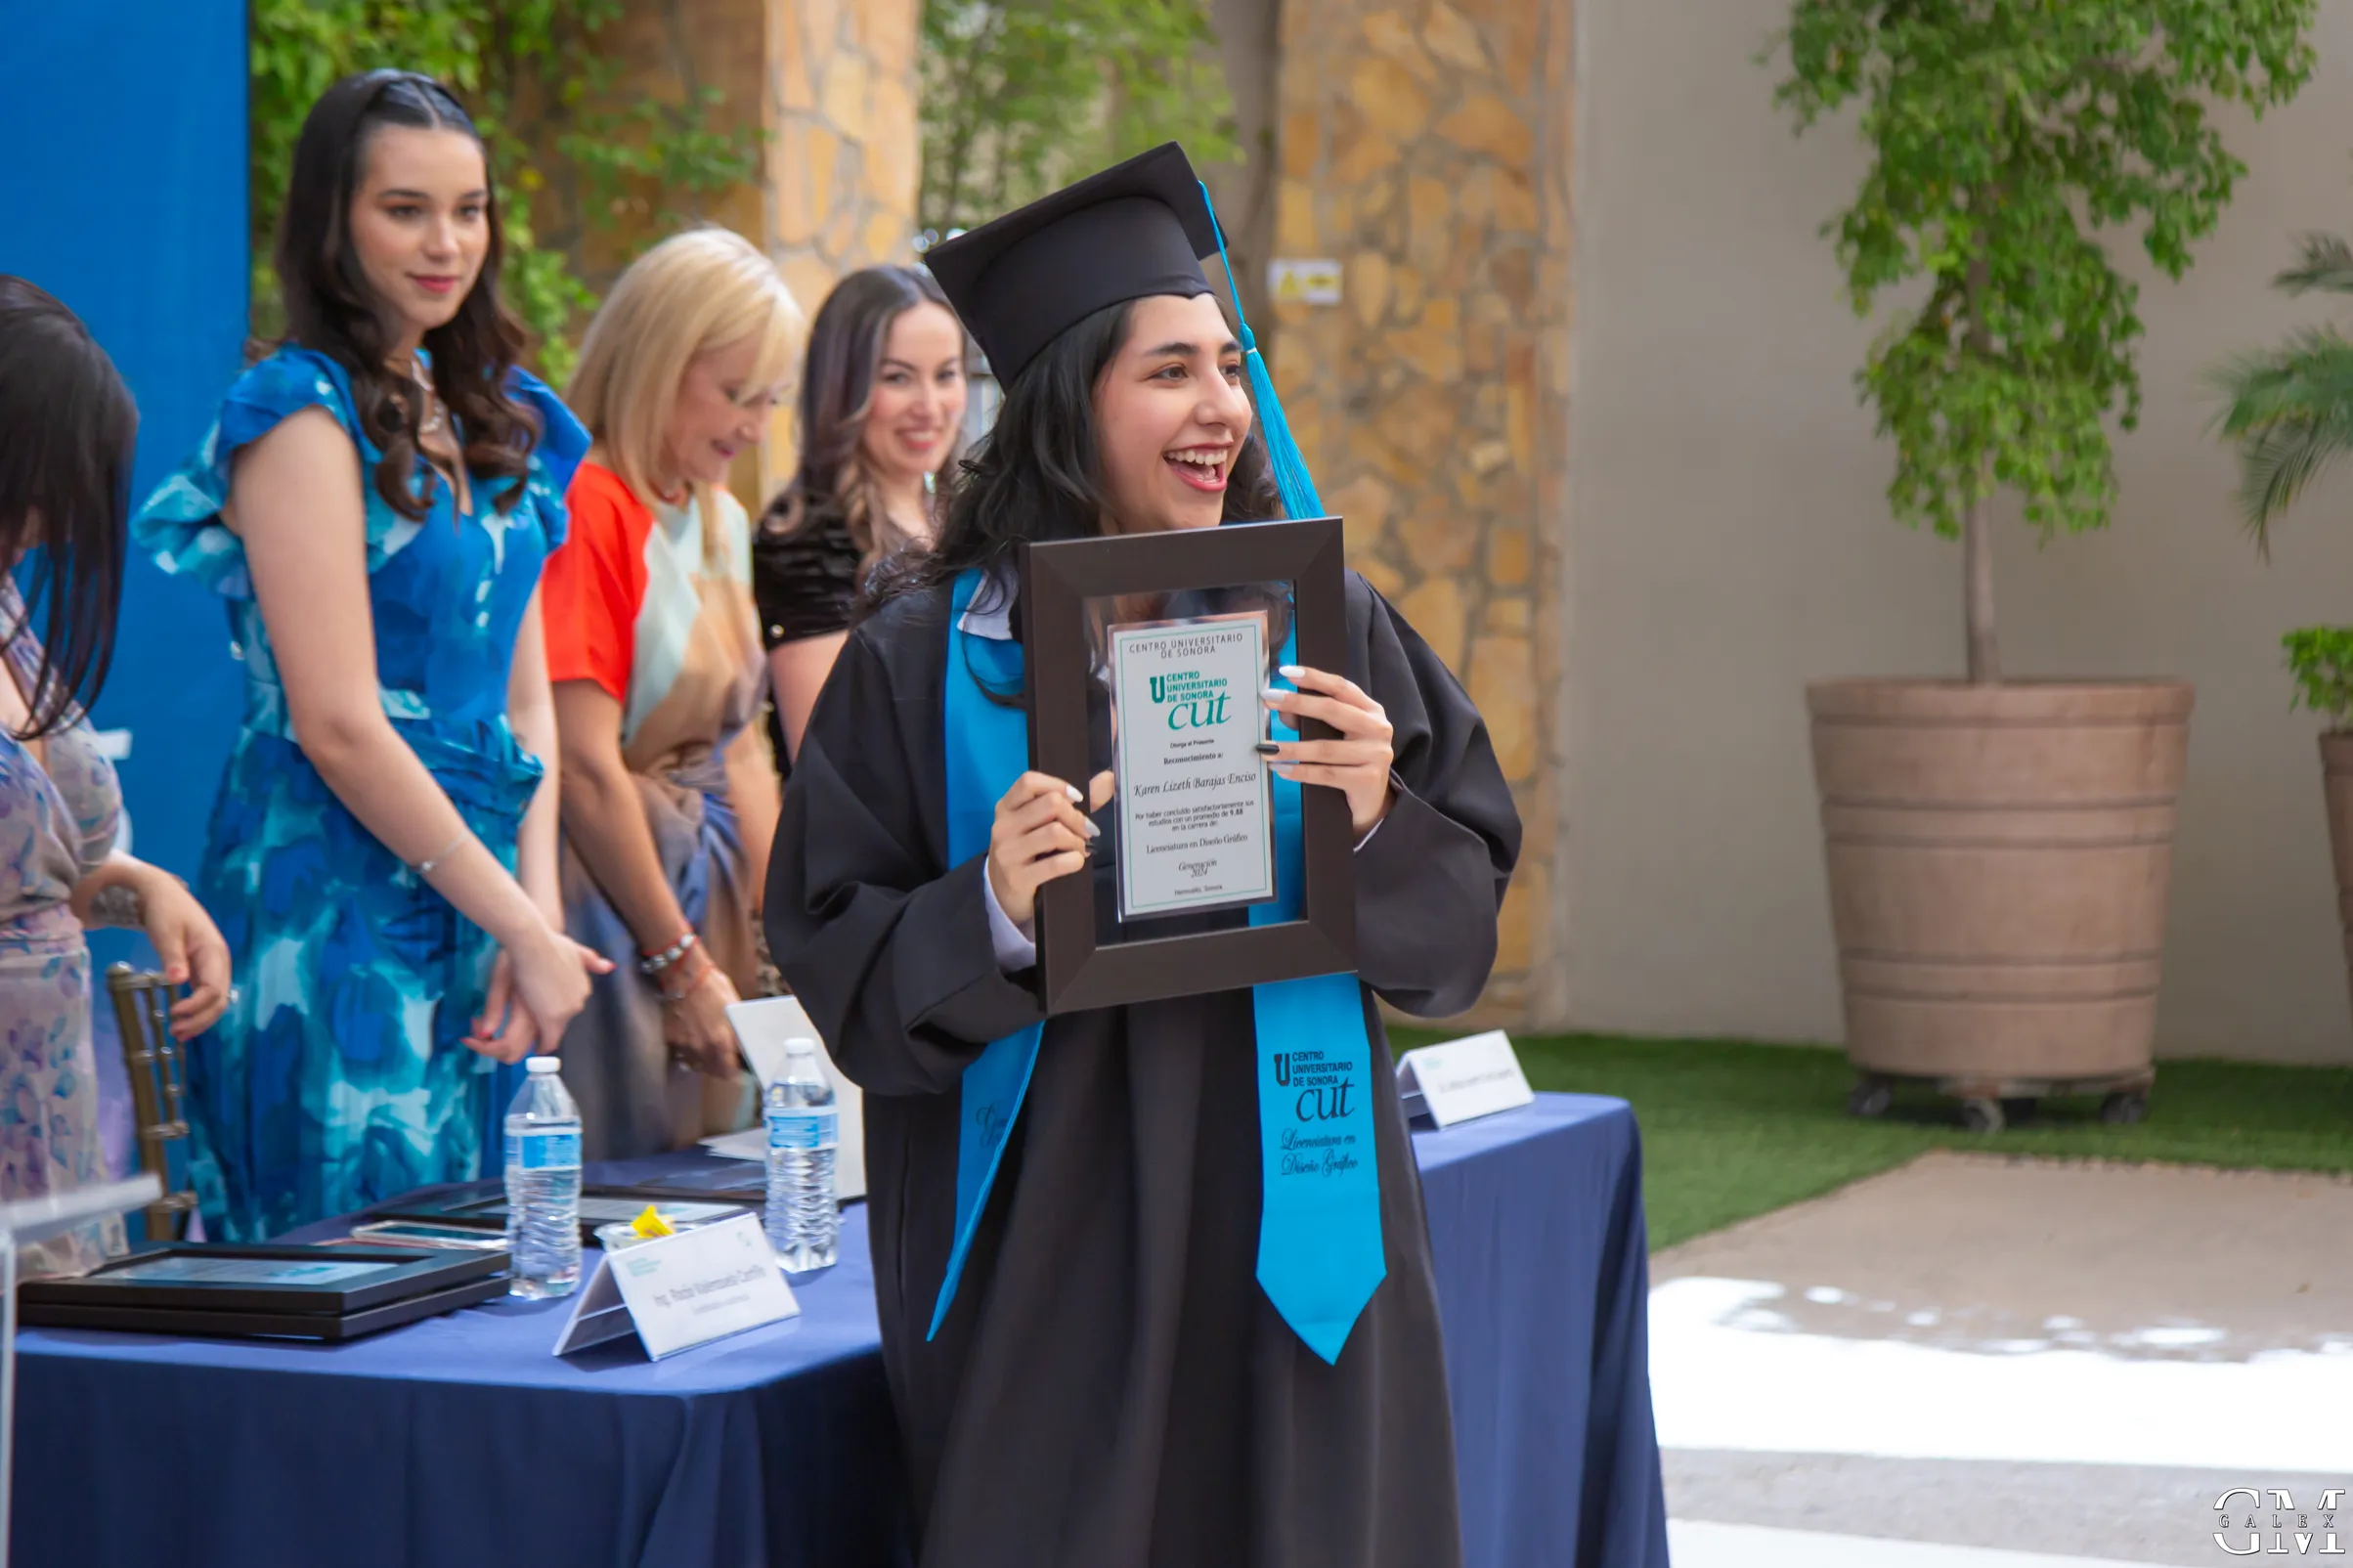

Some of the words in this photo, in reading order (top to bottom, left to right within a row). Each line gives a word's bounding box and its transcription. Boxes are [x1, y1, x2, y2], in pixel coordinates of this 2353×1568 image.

[1129, 640, 1166, 653] CENTRO
[1171, 632, 1242, 648] UNIVERSITARIO
[1161, 649, 1172, 659] DE
[1177, 645, 1216, 657] SONORA
[1167, 671, 1200, 682] CENTRO
[1167, 678, 1228, 692] UNIVERSITARIO
[1150, 675, 1165, 704] U
[1167, 693, 1177, 703] DE
[1180, 690, 1213, 702] SONORA
[1168, 691, 1232, 730] cut
[1163, 753, 1216, 764] Reconocimiento
[1134, 784, 1160, 798] Karen
[1162, 777, 1191, 793] Lizeth
[1193, 775, 1226, 790] Barajas
[1228, 771, 1256, 784] Enciso
[1146, 810, 1161, 819] haber
[1163, 807, 1191, 817] concluido
[1192, 801, 1243, 813] satisfactoriamente
[1149, 817, 1172, 827] estudios
[1193, 810, 1220, 822] promedio
[1147, 841, 1189, 854] Licenciatura
[1199, 837, 1223, 847] Diseño
[1224, 833, 1248, 844] Gráfico
[1179, 858, 1218, 872] Generación
[1191, 867, 1208, 878] 2024
[1292, 1051, 1324, 1062] CENTRO
[1274, 1054, 1290, 1087] U
[1292, 1062, 1353, 1074] UNIVERSITARIO
[1293, 1077, 1304, 1087] DE
[1307, 1075, 1338, 1087] SONORA
[1296, 1077, 1355, 1122] cut
[1281, 1128, 1341, 1151] Licenciatura
[1344, 1135, 1356, 1144] en
[1281, 1153, 1320, 1175] Diseño
[1322, 1148, 1358, 1178] Gráfico
